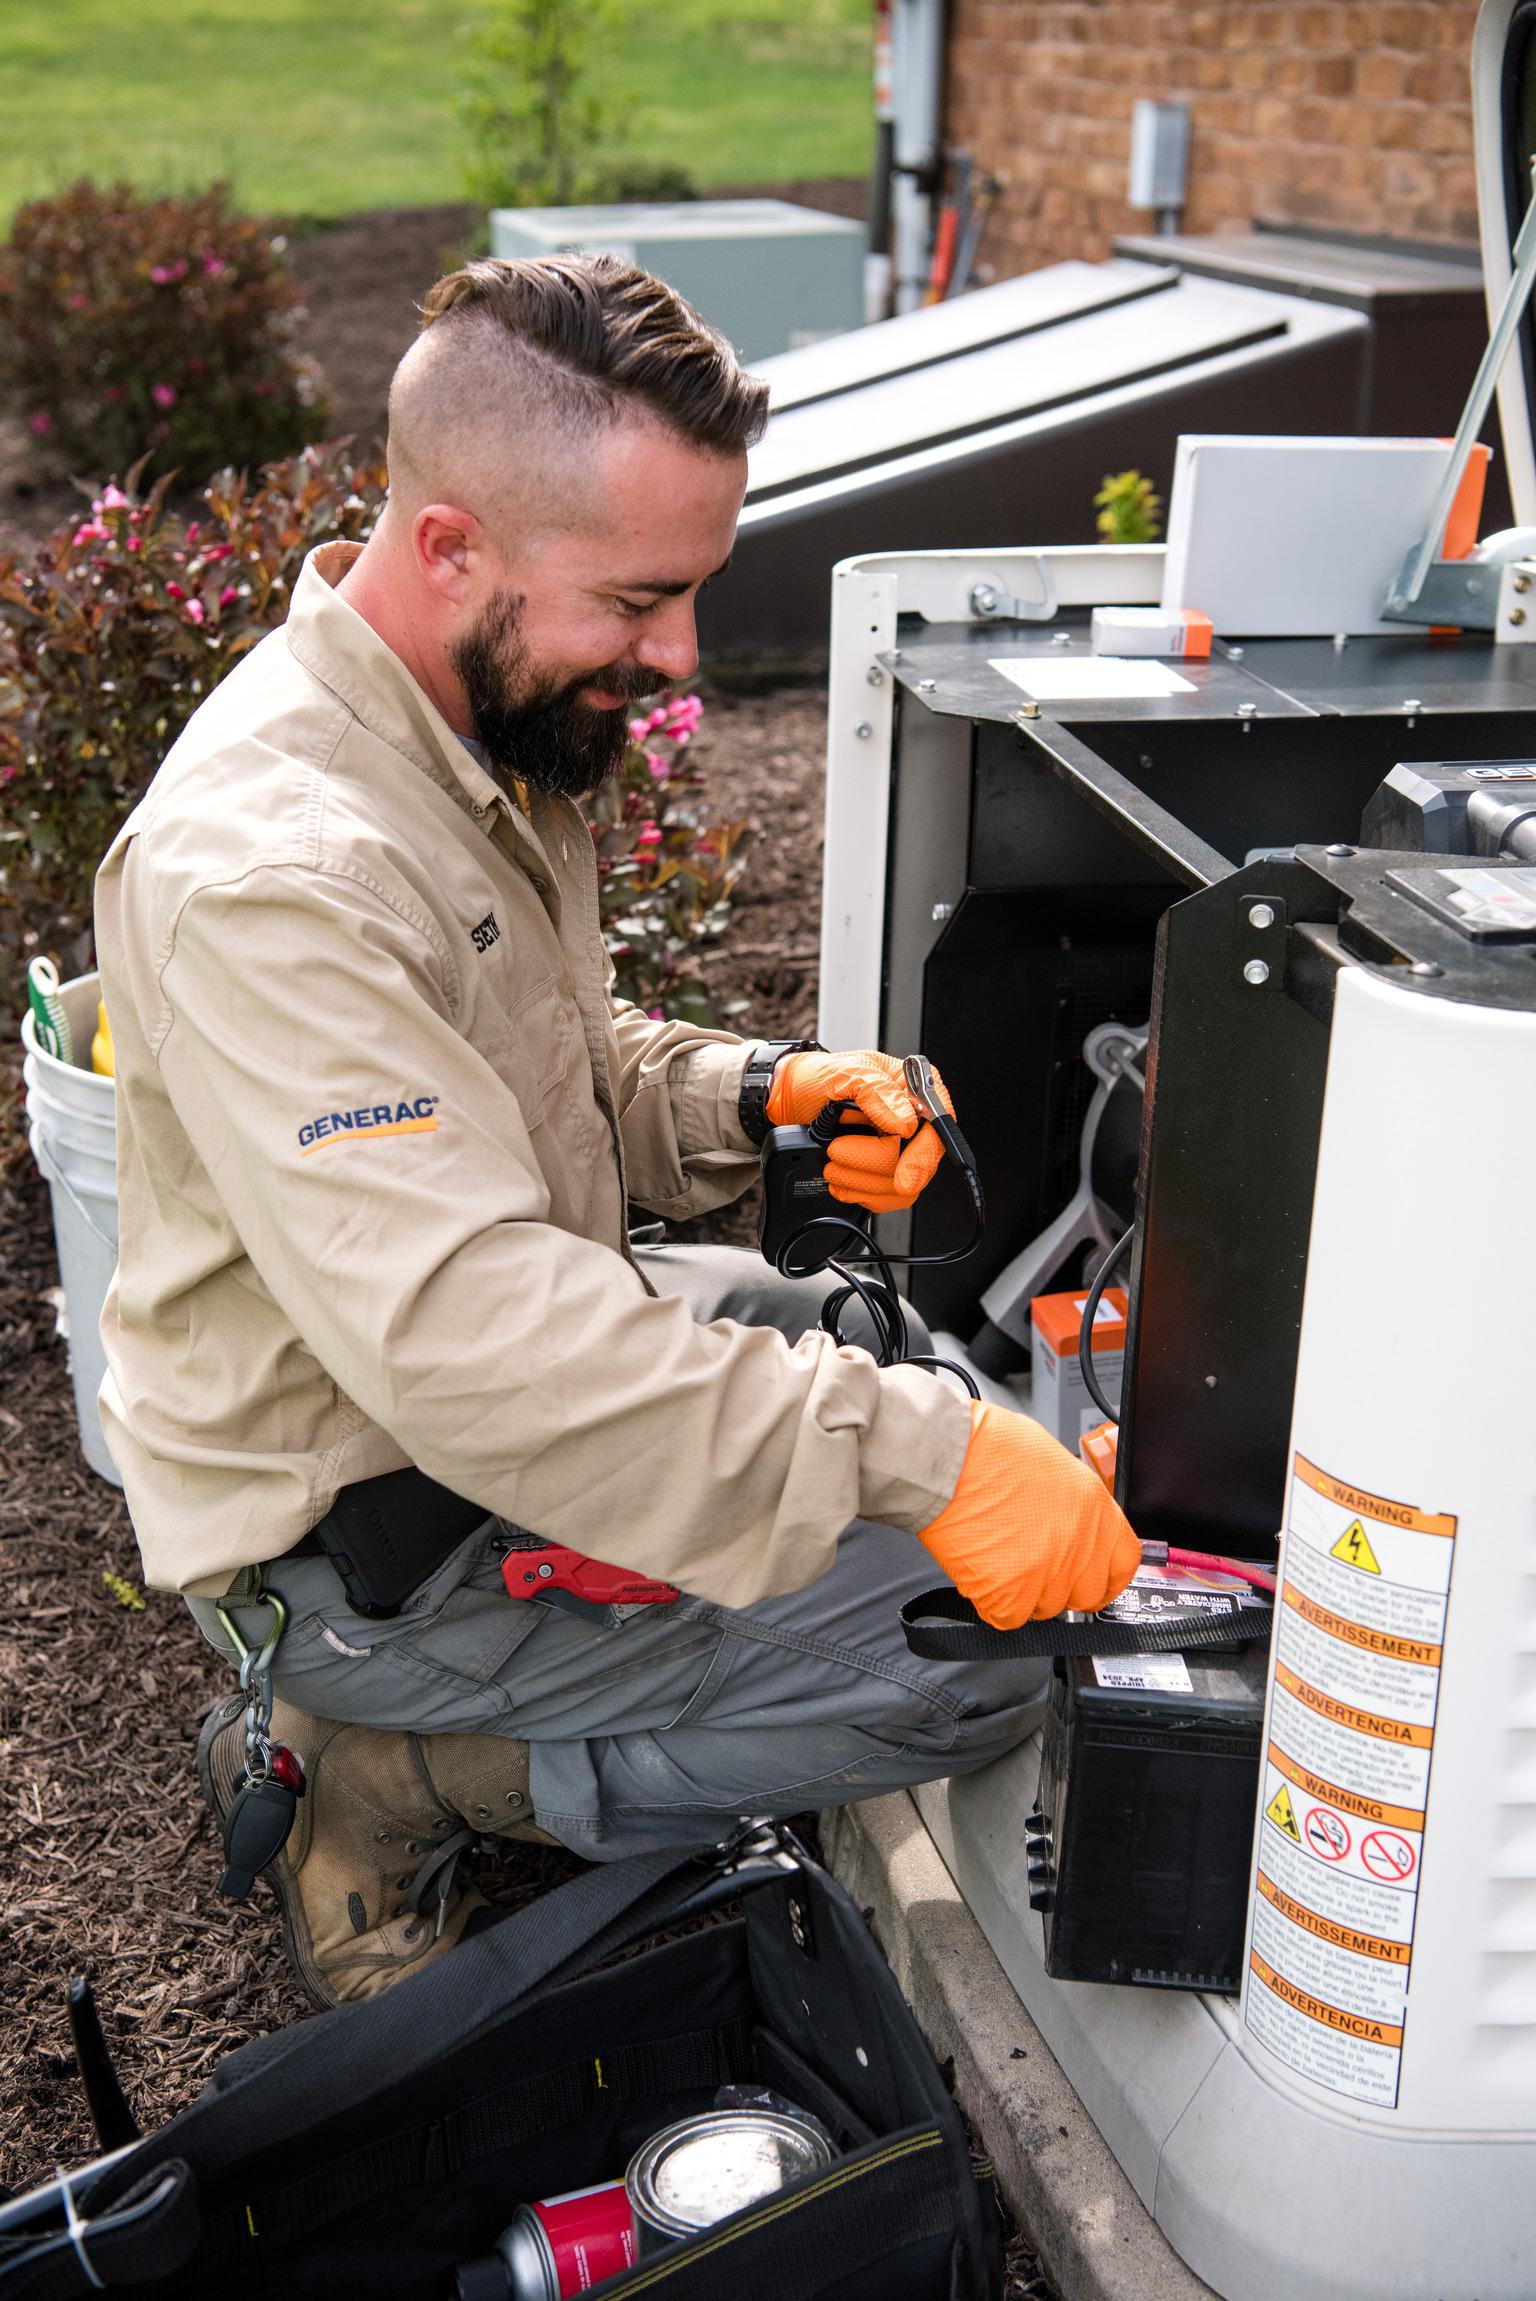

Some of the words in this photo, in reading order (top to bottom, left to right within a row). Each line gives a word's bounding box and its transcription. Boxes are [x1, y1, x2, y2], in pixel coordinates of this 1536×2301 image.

[298, 1097, 435, 1147] GENERAC
[1332, 1486, 1413, 1525] WARNING
[1299, 1597, 1434, 1661] AVERTISSEMENT
[1298, 1685, 1413, 1741] ADVERTENCIA
[1305, 1775, 1383, 1818] WARNING
[1272, 1891, 1405, 1959] AVERTISSEMENT
[1271, 1976, 1383, 2039] ADVERTENCIA
